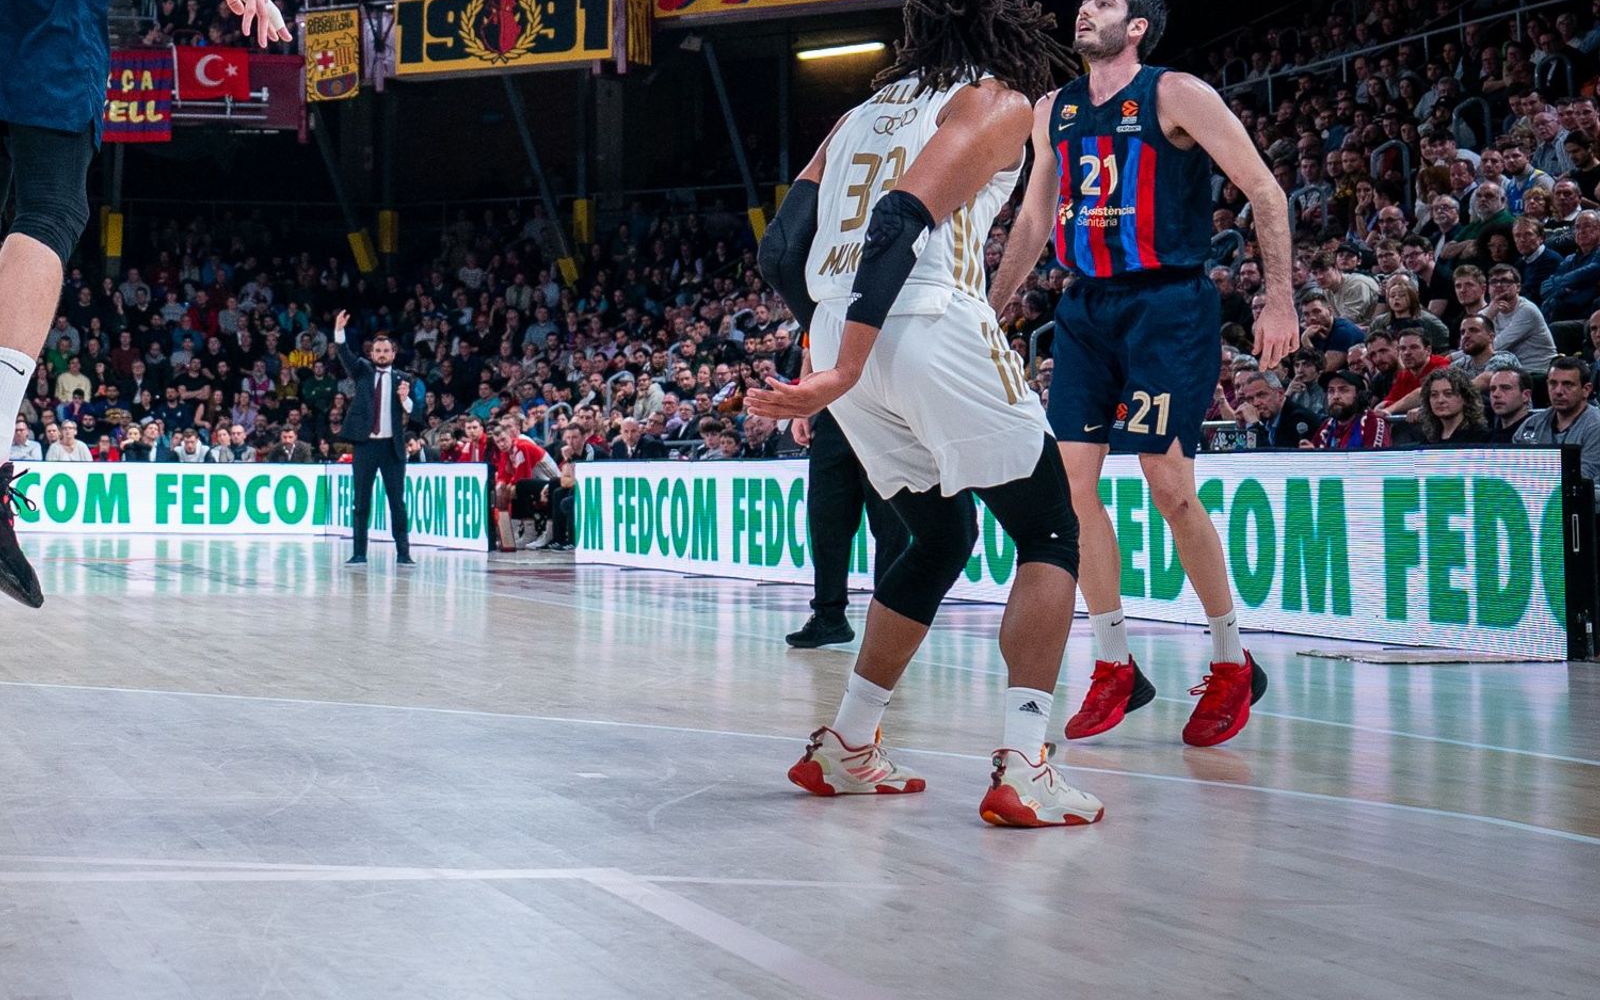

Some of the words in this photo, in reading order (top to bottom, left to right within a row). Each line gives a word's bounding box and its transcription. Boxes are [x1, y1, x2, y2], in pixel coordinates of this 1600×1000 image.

[1079, 154, 1119, 196] 21
[1079, 204, 1136, 216] Assistència
[1128, 390, 1172, 436] 21
[613, 476, 718, 562] FEDCOM
